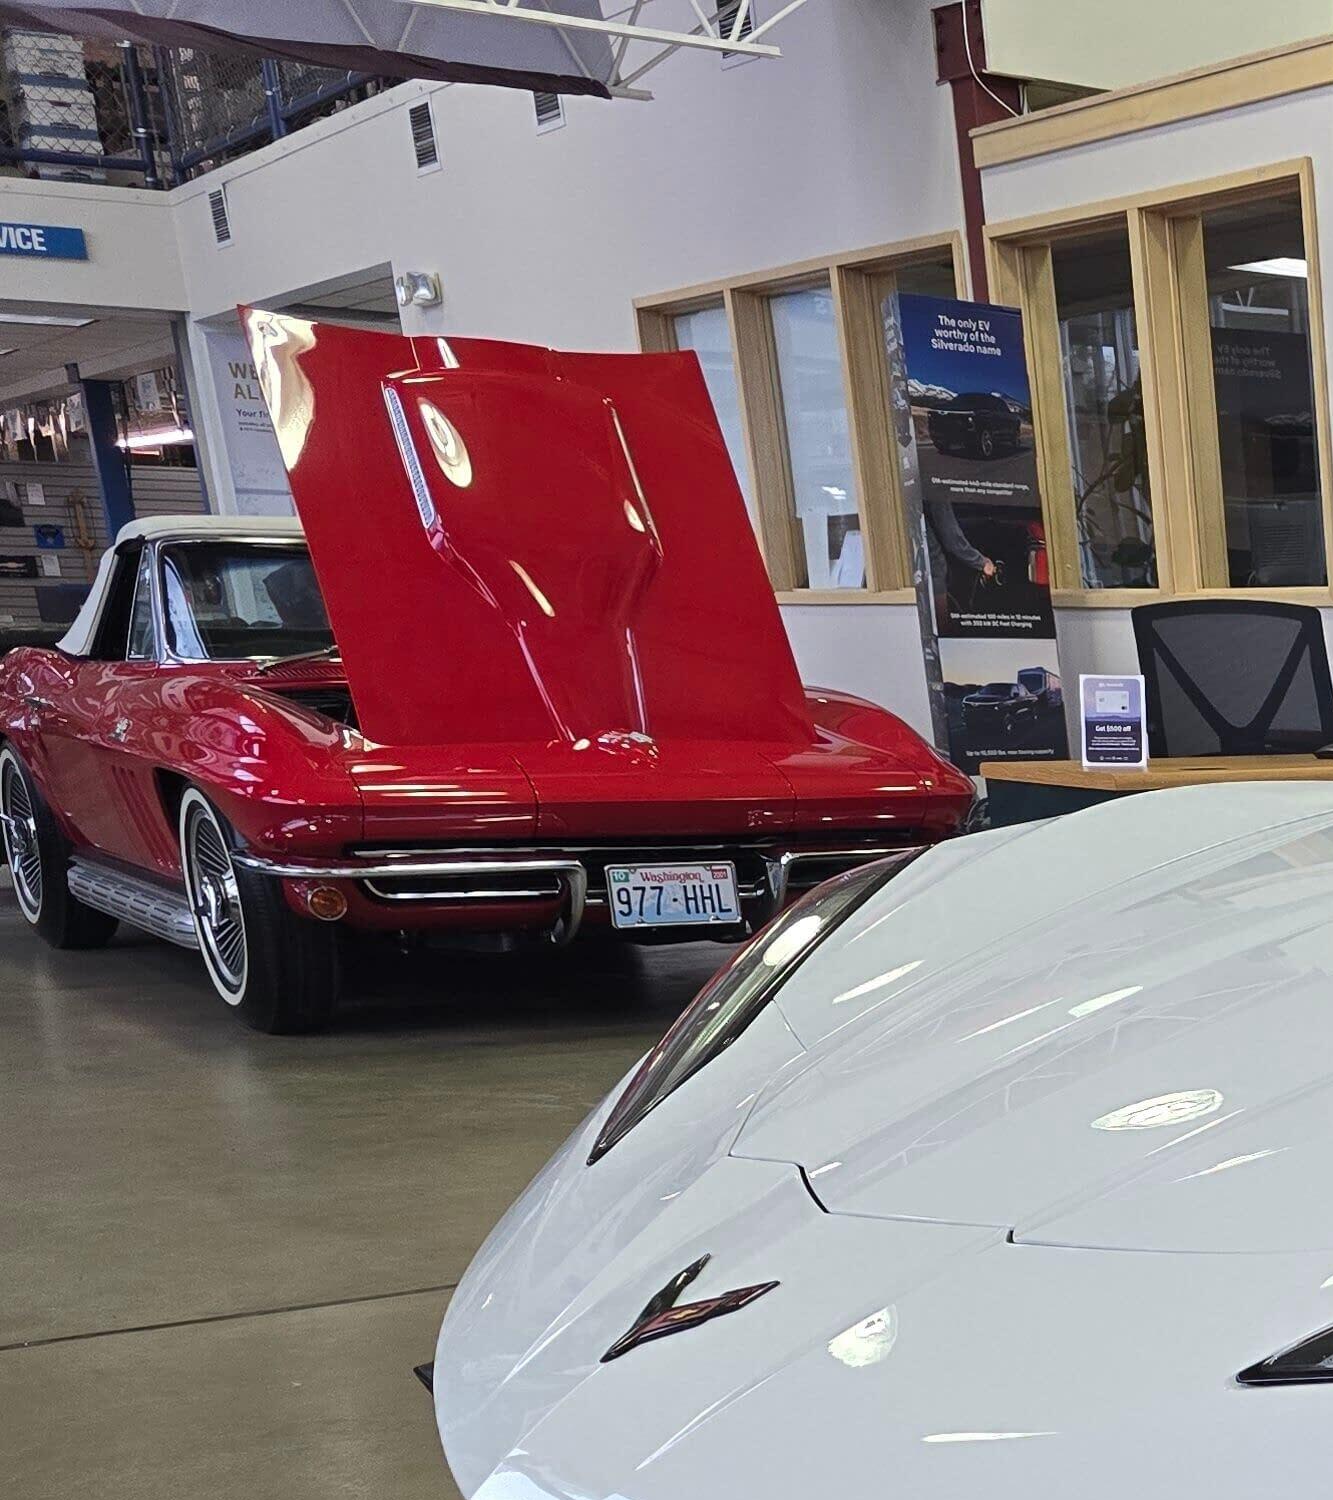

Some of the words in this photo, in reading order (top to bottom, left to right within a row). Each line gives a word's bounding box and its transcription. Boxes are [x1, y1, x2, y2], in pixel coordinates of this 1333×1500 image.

[938, 315, 956, 327] The
[957, 319, 977, 331] only
[978, 321, 990, 331] EV
[934, 329, 968, 342] worthy
[970, 331, 979, 342] of
[980, 332, 996, 344] the
[931, 339, 976, 353] Silverado
[977, 345, 1001, 356] name
[236, 409, 257, 418] Your
[640, 871, 704, 883] Washington
